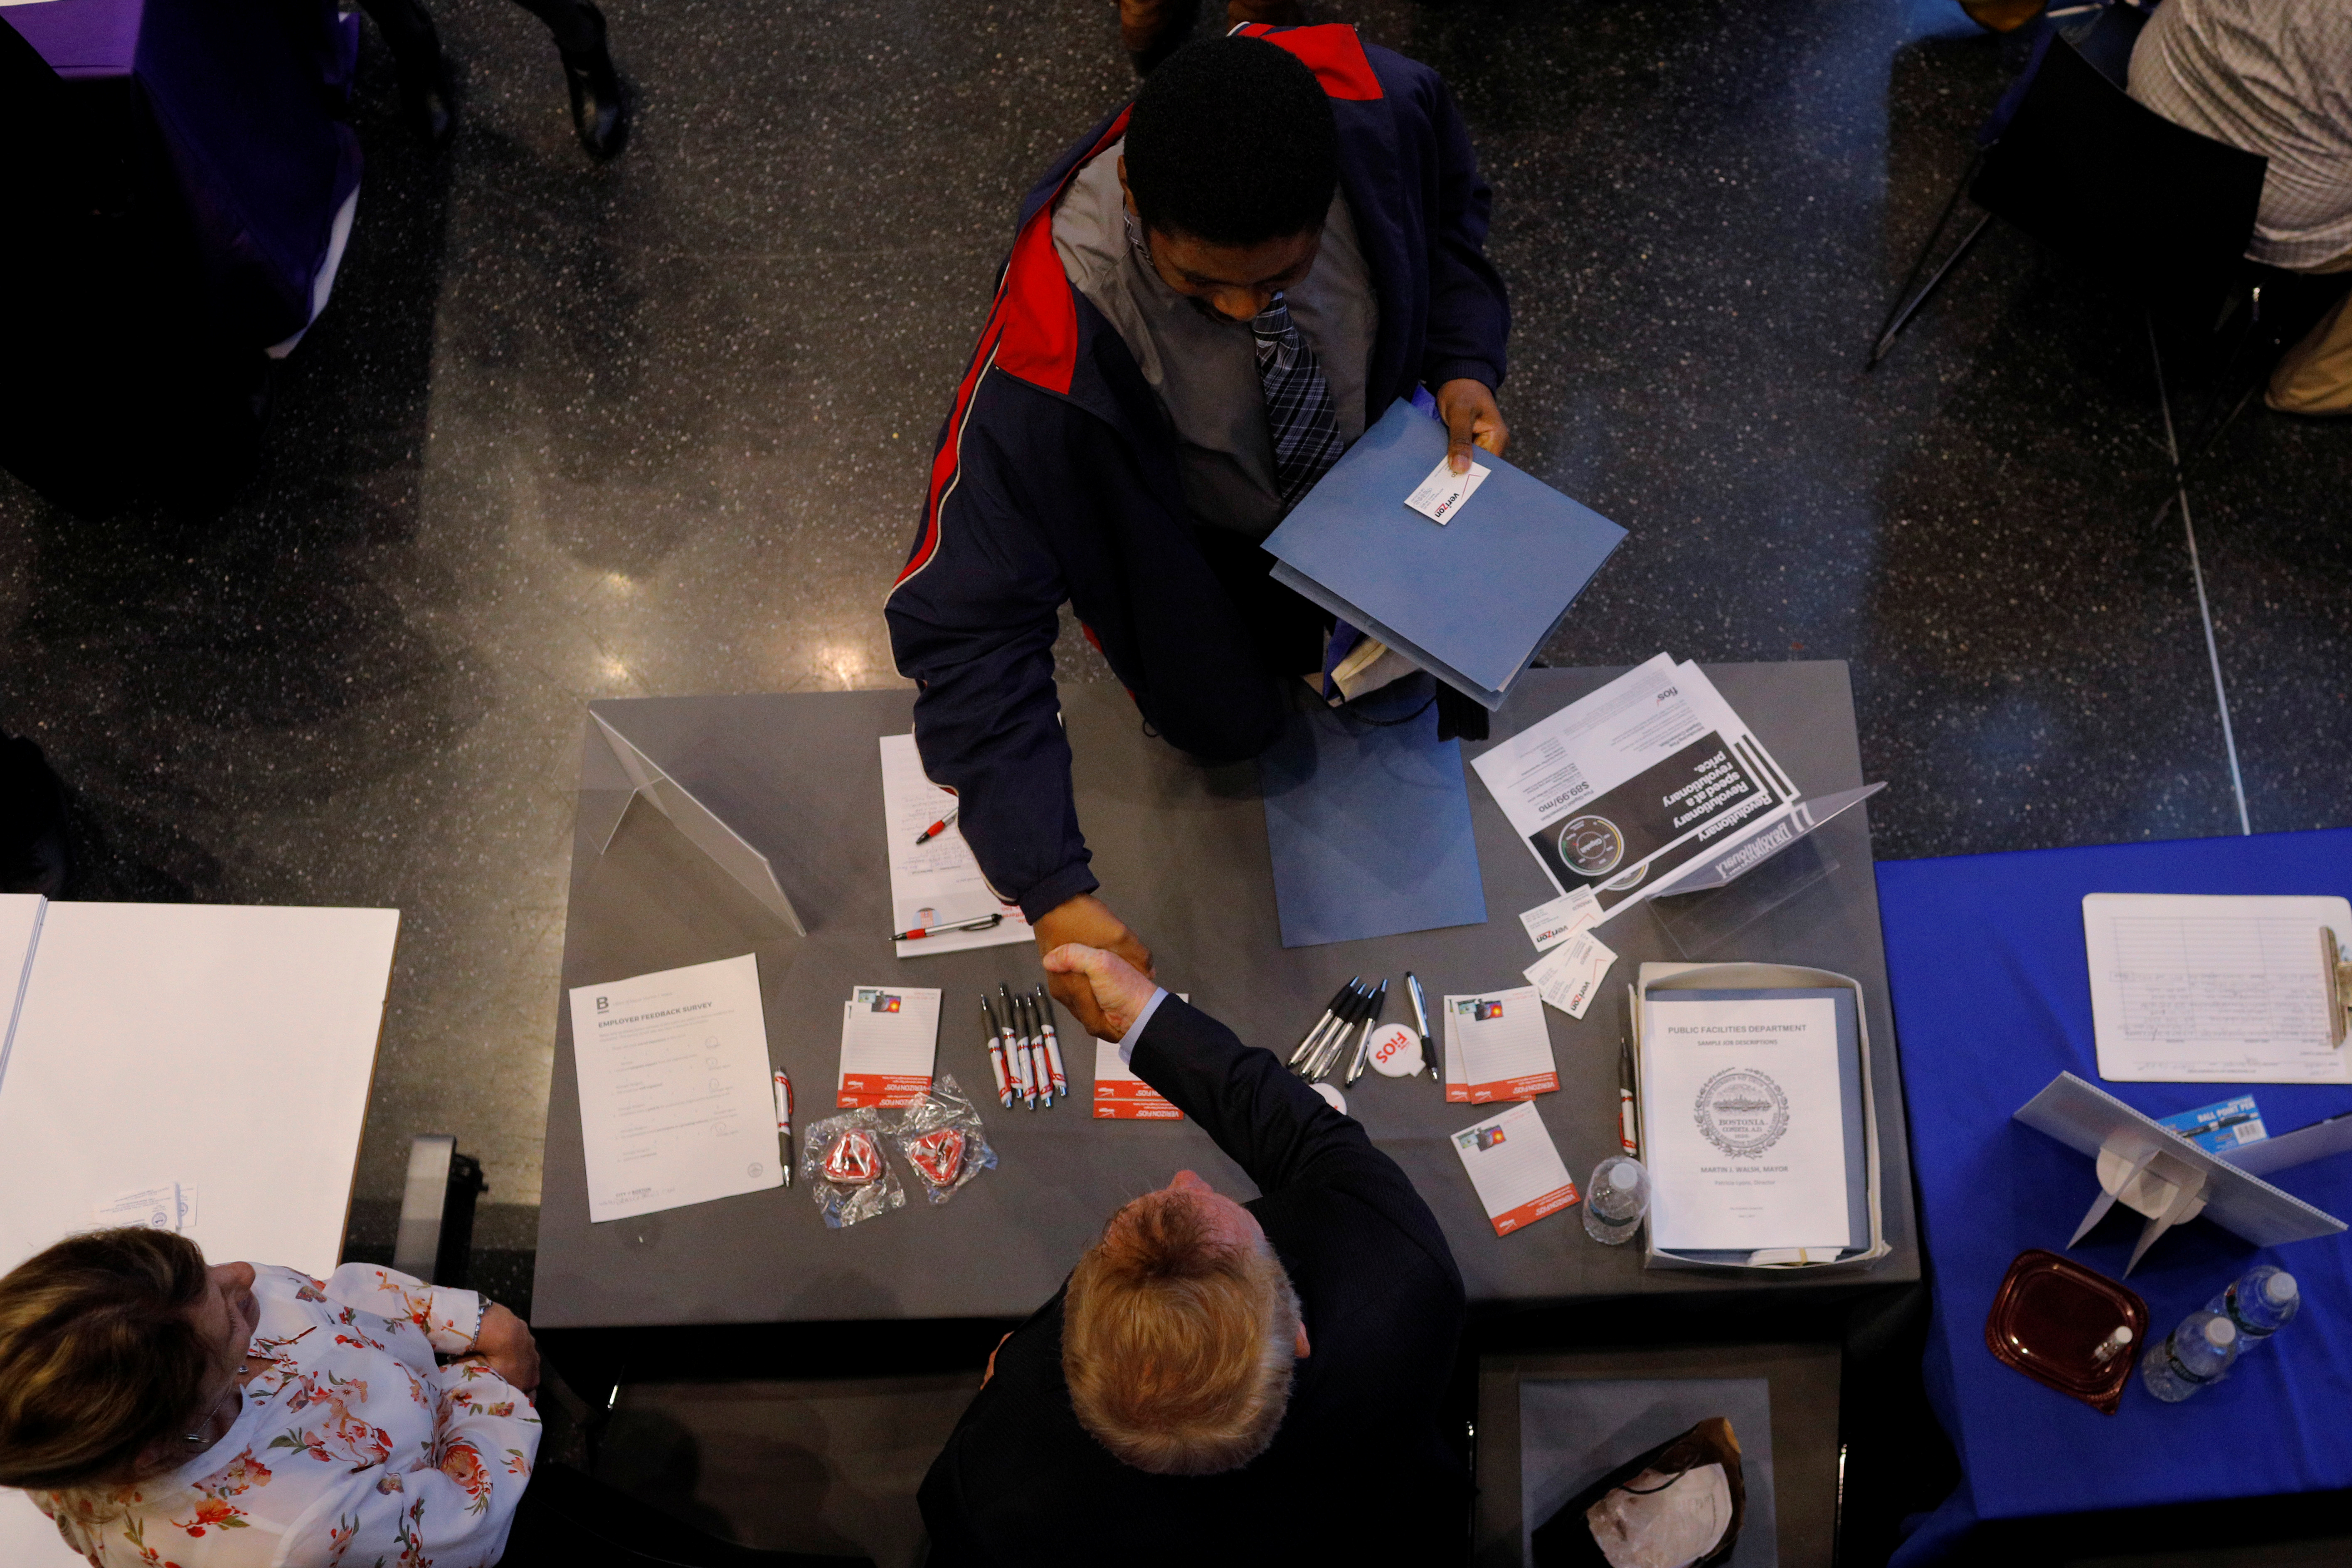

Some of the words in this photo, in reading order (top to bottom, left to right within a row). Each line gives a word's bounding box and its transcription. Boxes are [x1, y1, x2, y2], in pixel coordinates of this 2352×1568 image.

[1434, 493, 1460, 517] verizon
[1694, 750, 1726, 773] price.
[1663, 762, 1733, 807] revolutionary
[1693, 790, 1706, 803] at
[1706, 772, 1741, 797] speed
[1538, 782, 1590, 812] $89.99/mo
[1673, 781, 1749, 828] Revolutionary
[1685, 797, 1695, 806] a
[1698, 794, 1773, 842] Revolutionary
[1536, 925, 1568, 942] verizon
[596, 996, 609, 1010] B
[1570, 981, 1590, 1011] verizon
[598, 1016, 639, 1028] EMPLOYER
[641, 1008, 680, 1021] FEEDBACK
[683, 1002, 712, 1013] SURVEY
[1749, 1024, 1807, 1033] DEPARTMENT
